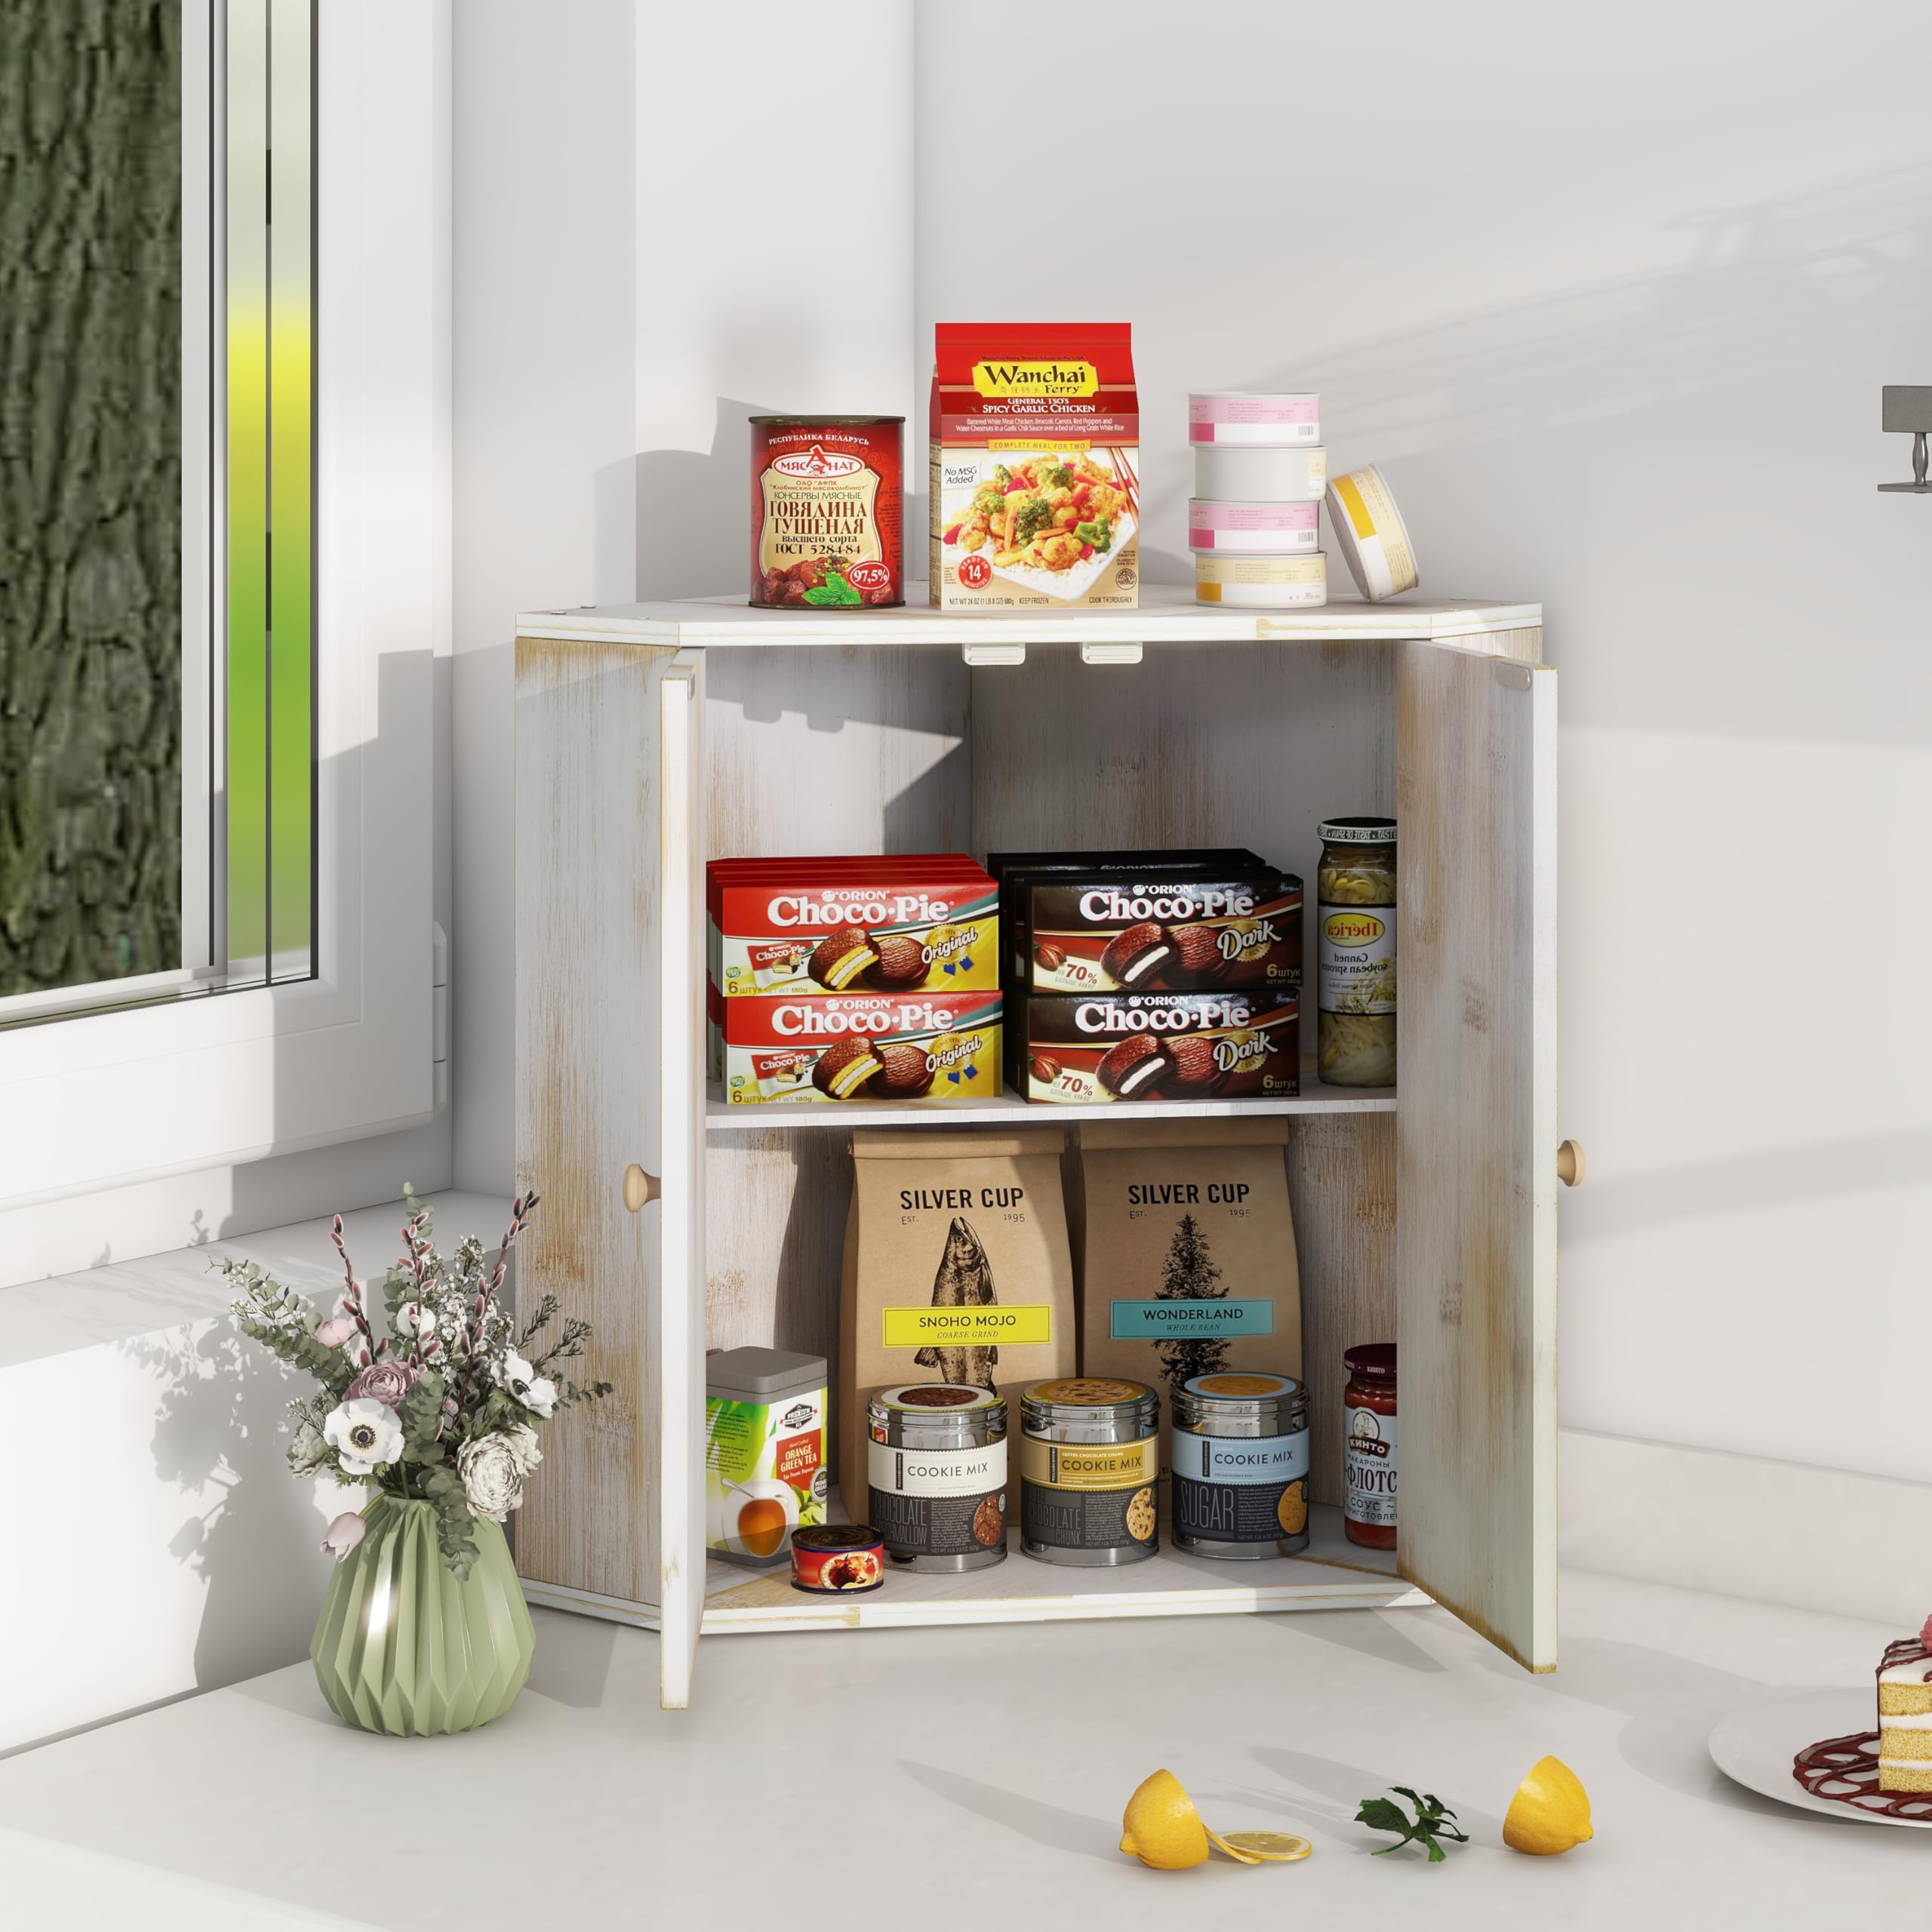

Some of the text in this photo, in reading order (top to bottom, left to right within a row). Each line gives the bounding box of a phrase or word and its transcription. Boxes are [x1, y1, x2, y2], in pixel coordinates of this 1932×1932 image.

[983, 365, 1086, 386] Wanchai
[1044, 384, 1080, 394] Ferry
[983, 404, 1096, 414] SPICY GARLIC CHICKEN
[768, 434, 870, 445] РЕСПУБЛИКА БЕЛАРУСЬ
[945, 466, 977, 476] No MSG
[946, 475, 974, 484] Added
[774, 491, 863, 500] КОНСЕРВЫ МЯСНЫЕ
[771, 500, 867, 518] ГОВЯДИНА
[773, 518, 864, 534] ТУШЕНАЯ
[829, 536, 857, 545] сорта
[774, 543, 861, 555] ГОСТ 5284-84
[961, 555, 989, 570] READY IN
[853, 569, 889, 584] 97,5%
[968, 565, 981, 580] 14
[964, 578, 988, 588] MINUTES
[839, 891, 887, 900] ORION
[1148, 884, 1192, 895] ORION
[921, 927, 978, 964] Original
[1217, 920, 1282, 960] Dark
[1066, 963, 1097, 984] 70%
[1266, 963, 1278, 977] 6
[728, 981, 738, 994] 6
[843, 999, 891, 1009] ORION
[1144, 996, 1188, 1005] ORION
[925, 1035, 982, 1072] Original
[1213, 1031, 1278, 1071] Dark
[1061, 1075, 1094, 1097] 70%
[1263, 1075, 1275, 1089] 6
[732, 1091, 743, 1103] 6
[900, 1187, 1024, 1210] SILVER CUP
[1128, 1183, 1251, 1205] SILVER CUP
[901, 1214, 1026, 1225] EST. 1995
[1129, 1208, 1251, 1220] EST. 1995
[919, 1315, 1017, 1327] SNOHO MOJO
[1143, 1309, 1244, 1321] WONDERLAND
[787, 1407, 811, 1420] PREMIUM
[785, 1443, 813, 1461] ORANGE
[1349, 1438, 1386, 1454] КИНТО
[780, 1452, 817, 1472] GREEN TEA
[1062, 1456, 1142, 1471] COOKIE MIX
[1214, 1450, 1293, 1465] COOKIE MIX
[1347, 1454, 1390, 1468] МАКАРОНЫ
[907, 1462, 988, 1477] COOKIE MIX
[875, 1491, 928, 1527] CHOCOLATE
[1180, 1480, 1234, 1531] SUGAR
[1350, 1497, 1381, 1511] СОУС
[1029, 1500, 1081, 1531] CHOCOLATE
[1056, 1527, 1081, 1546] CHUNK
